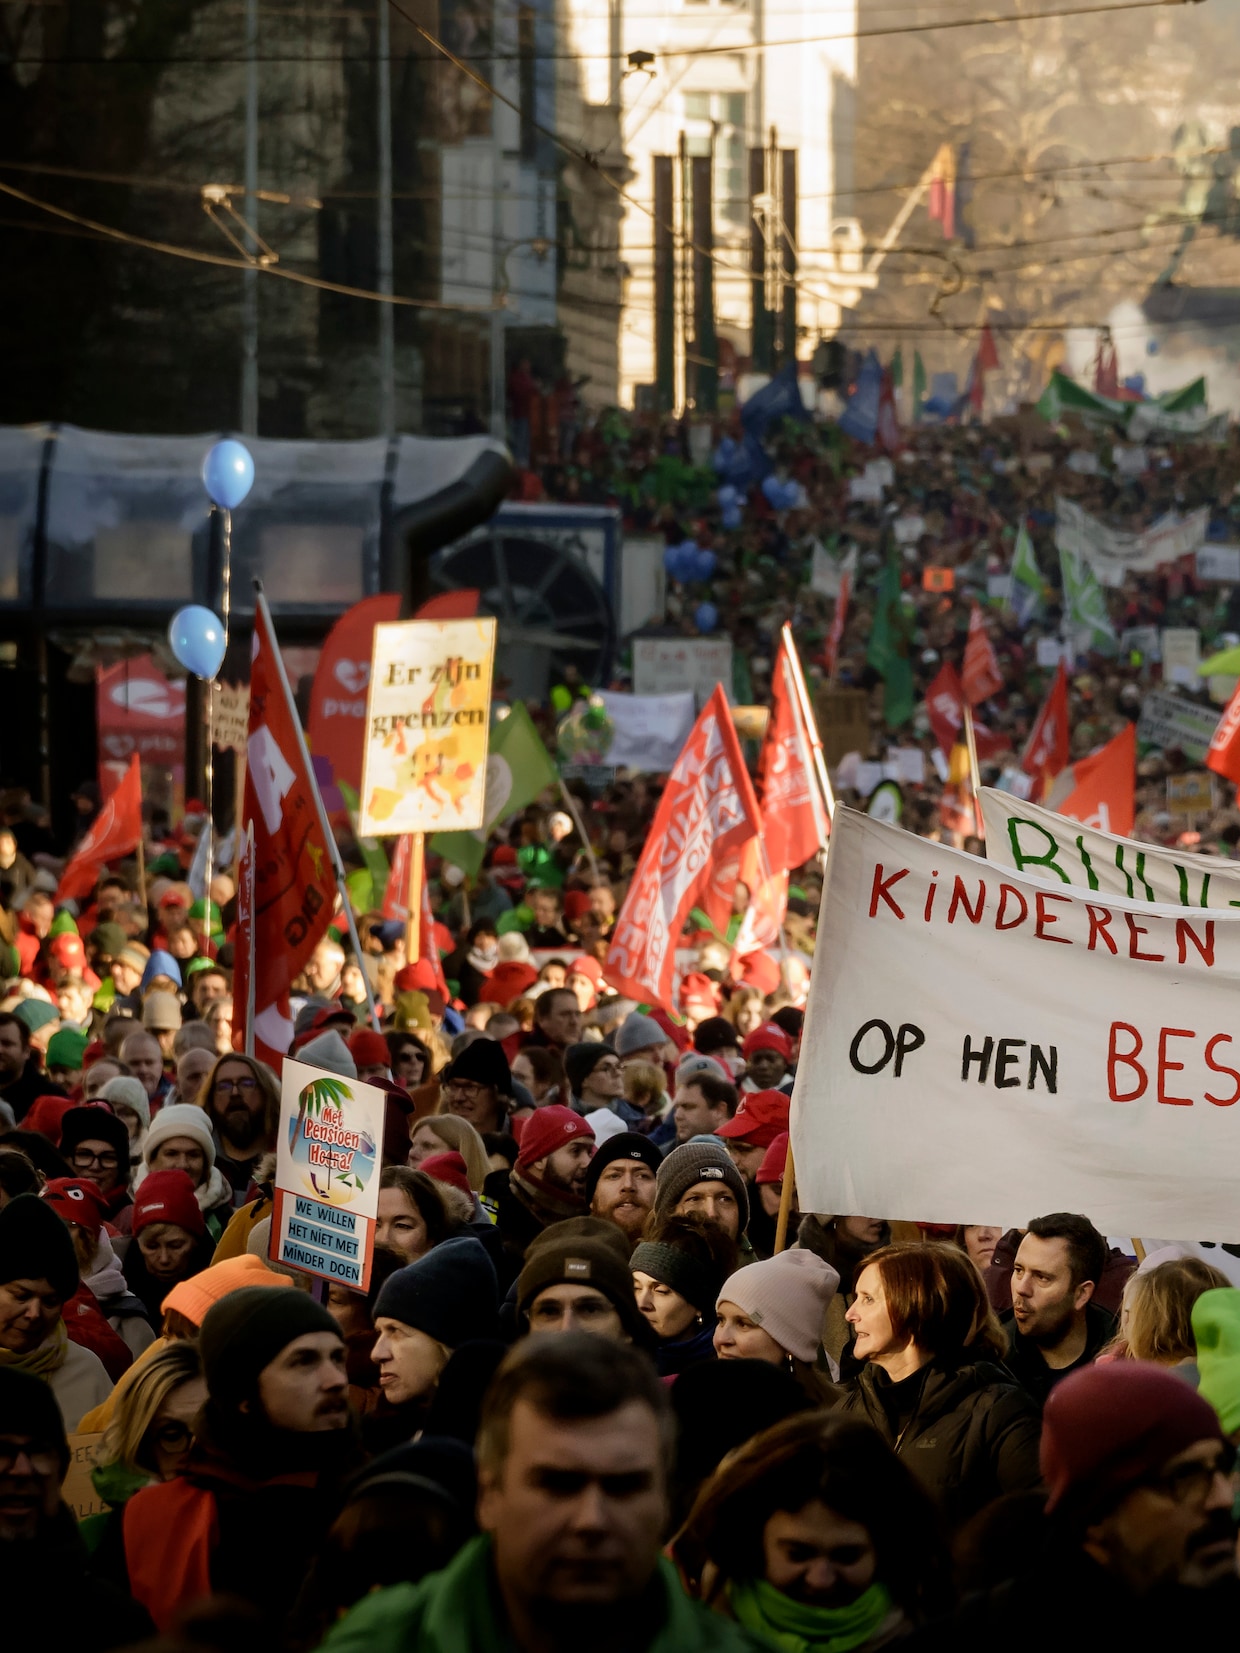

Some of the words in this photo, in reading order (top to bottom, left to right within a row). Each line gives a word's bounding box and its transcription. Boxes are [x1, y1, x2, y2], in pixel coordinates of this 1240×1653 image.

[387, 662, 421, 687] Er
[322, 699, 367, 719] pvd
[373, 708, 485, 739] grenzen
[869, 862, 1216, 968] KiNDEREN
[848, 1018, 926, 1078] OP
[962, 1035, 1058, 1094] HEN
[322, 1106, 343, 1129] Met
[305, 1119, 359, 1148] Pensioen
[296, 1198, 312, 1216] WE
[289, 1222, 307, 1239] HET
[336, 1239, 359, 1256] MET
[329, 1262, 360, 1281] DOEN
